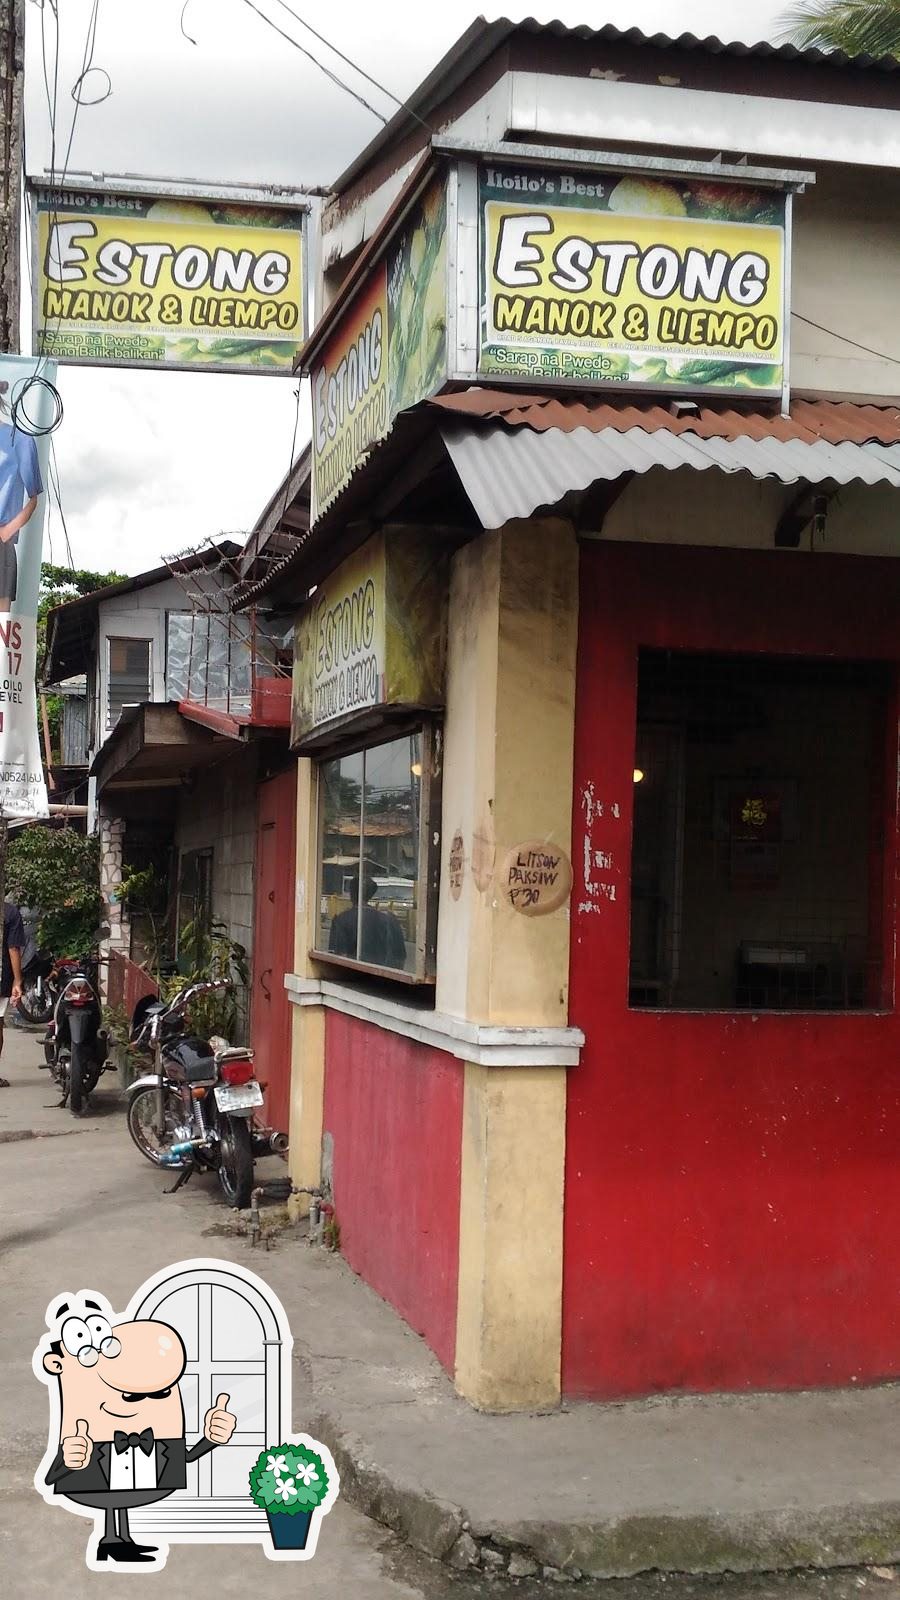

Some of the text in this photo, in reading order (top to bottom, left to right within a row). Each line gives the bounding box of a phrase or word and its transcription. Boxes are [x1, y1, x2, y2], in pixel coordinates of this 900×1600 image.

[486, 169, 605, 198] Iloilo's Best
[103, 194, 143, 210] Best
[44, 219, 291, 295] ESTONG
[493, 212, 770, 307] ESTONG
[43, 288, 154, 323] MANOK
[158, 294, 182, 325] &
[190, 296, 299, 331] LIEMPO
[493, 294, 616, 339] MANOK
[622, 303, 649, 341] &
[657, 305, 779, 350] LIEMPO
[85, 334, 102, 346] na
[105, 334, 149, 347] Pwede
[541, 353, 560, 366] na
[562, 352, 612, 370] Pwede
[316, 306, 383, 457] ESTONG
[315, 578, 376, 680] ESTONG
[8, 651, 22, 676] 17
[517, 851, 561, 869] LITSON
[508, 867, 559, 886] PAKSIW
